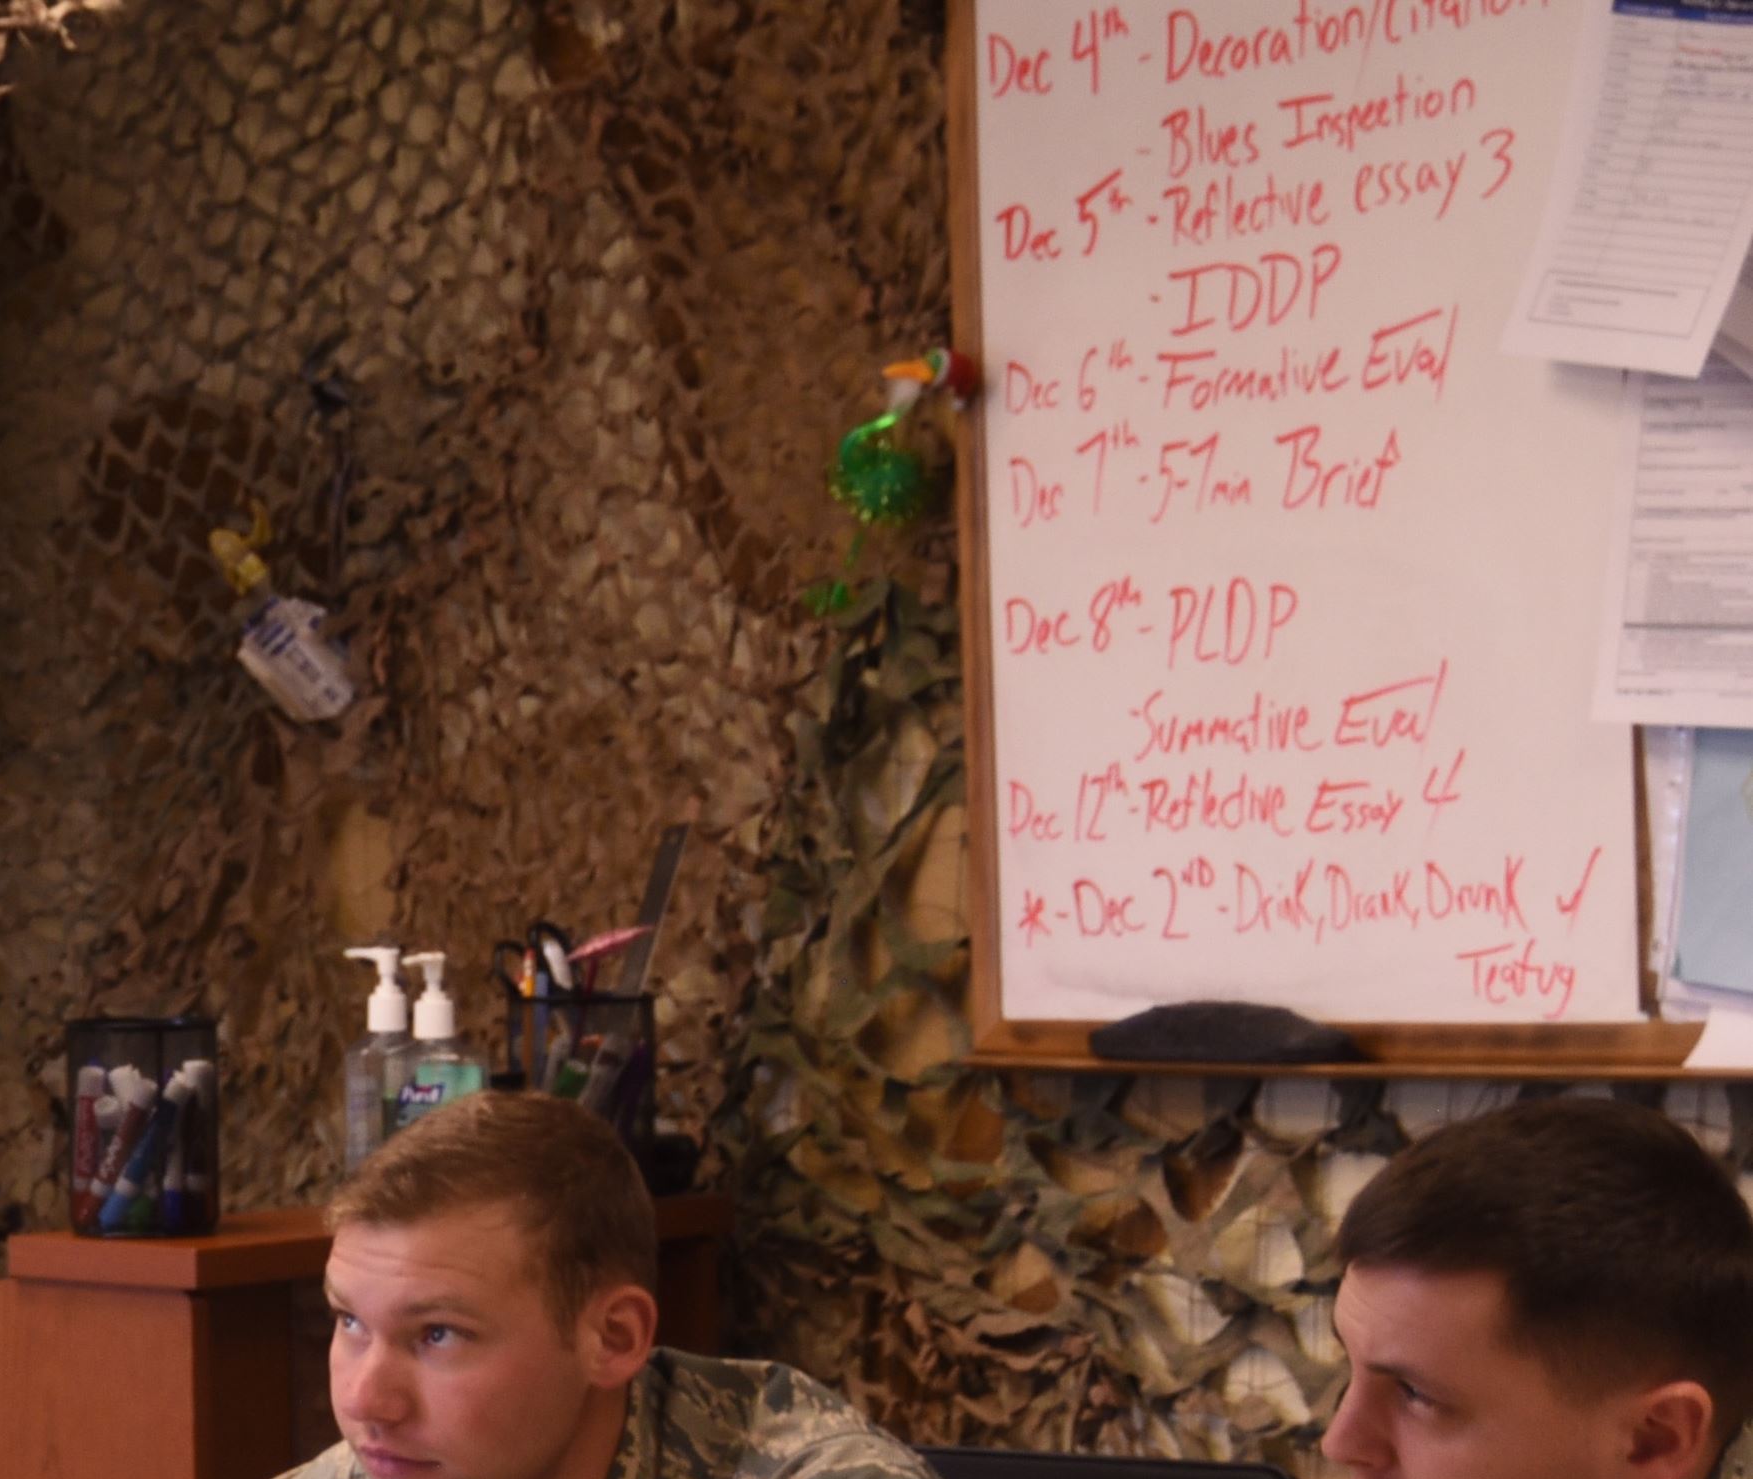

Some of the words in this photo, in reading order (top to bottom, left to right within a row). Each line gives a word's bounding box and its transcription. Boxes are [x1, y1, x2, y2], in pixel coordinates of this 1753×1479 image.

[988, 32, 1055, 97] Dec
[1160, 105, 1260, 180] Blues
[1278, 75, 1478, 151] Inspection
[997, 201, 1064, 263] Dec
[1161, 177, 1331, 245] Reflective
[1481, 127, 1517, 200] 3
[1167, 240, 1344, 338] IDDP
[1006, 358, 1061, 415] Dec
[1155, 346, 1349, 413] Formative
[1361, 303, 1460, 400] Eval
[1009, 453, 1065, 529] Dec
[1274, 423, 1403, 511] Brief
[1006, 595, 1081, 656] Dec
[1167, 575, 1301, 669] PLDP
[1333, 655, 1451, 749] Eval
[1009, 778, 1063, 842] Dec
[1305, 777, 1407, 836] Essay
[1422, 747, 1469, 817] 4
